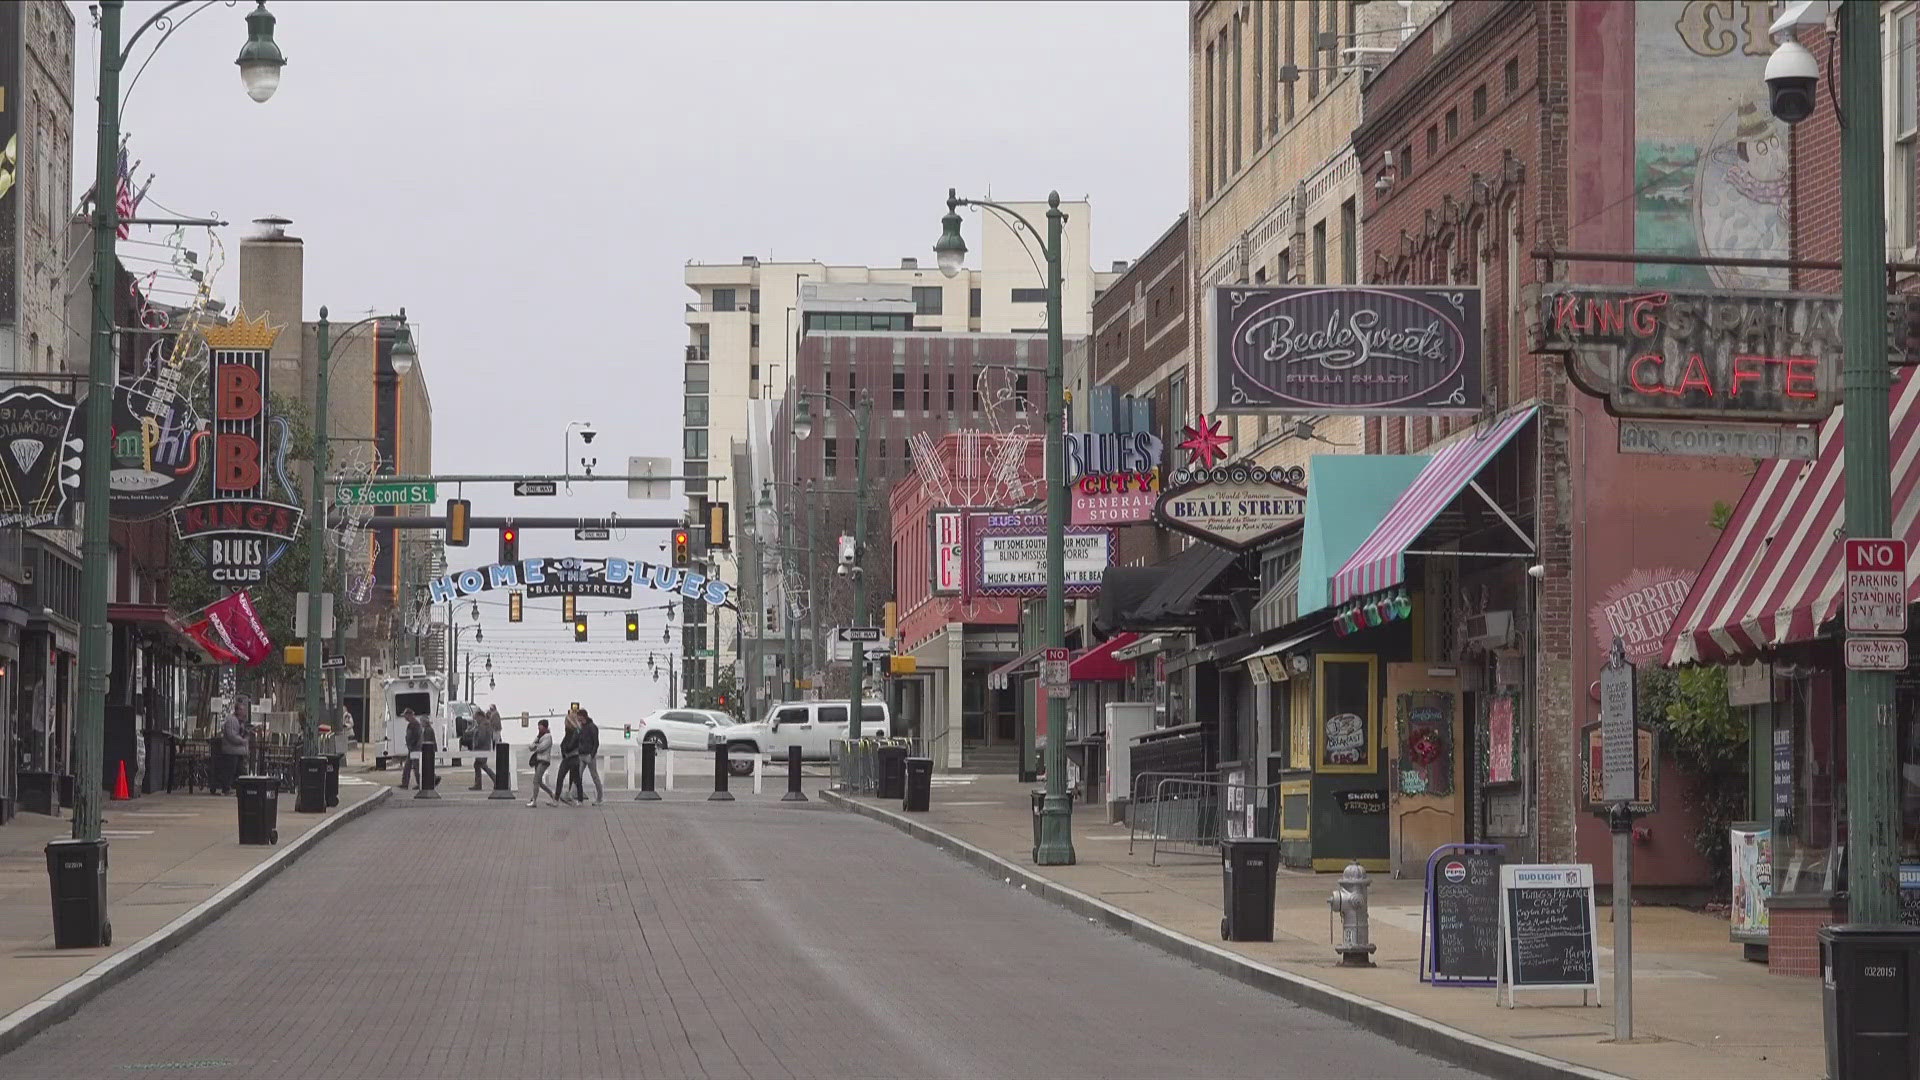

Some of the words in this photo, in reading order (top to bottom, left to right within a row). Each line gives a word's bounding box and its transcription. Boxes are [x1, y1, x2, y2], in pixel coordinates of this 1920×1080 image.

[1286, 373, 1344, 384] SUGAR
[1351, 373, 1410, 384] SHACK
[1631, 353, 1818, 399] CAFE
[1063, 431, 1153, 488] BLUES
[1176, 467, 1302, 483] WELCOME
[526, 485, 539, 493] ONE
[540, 485, 553, 493] WAY
[1080, 473, 1156, 496] CITY
[358, 487, 407, 504] Second
[410, 486, 432, 502] St.
[1077, 495, 1152, 509] GENERAL
[1174, 501, 1232, 517] BEALE
[1238, 500, 1305, 516] STREET
[186, 504, 289, 533] KING'S
[1090, 508, 1140, 520] STORE
[988, 515, 1021, 527] BLUES
[1024, 515, 1047, 526] CITY
[993, 540, 1005, 549] PUT
[1007, 540, 1024, 549] SOME
[1025, 539, 1046, 549] SOUTH
[1075, 537, 1099, 548] MOUTH
[212, 539, 262, 565] BLUES
[1000, 551, 1020, 561] BLIND
[1857, 544, 1894, 567] NO
[561, 557, 583, 569] OF
[212, 568, 262, 581] CLUB
[558, 569, 590, 582] THE
[988, 573, 1009, 584] MUSIC
[1010, 573, 1016, 582] &
[1017, 573, 1036, 583] MEAT
[1037, 572, 1047, 582] TH
[1079, 571, 1088, 581] BE
[1851, 574, 1898, 587] PARKING
[429, 557, 545, 606] HOME
[605, 557, 731, 606] BLUES
[535, 585, 573, 594] BEALE
[578, 583, 624, 594] STREET
[1851, 591, 1902, 605] STANDING
[1604, 578, 1690, 638] BURRITO
[1851, 605, 1875, 617] ANY
[1050, 650, 1065, 659] NO
[1862, 655, 1890, 664] ZONE
[1518, 873, 1538, 881] BUD
[1538, 873, 1563, 881] LIGHT
[1900, 871, 1920, 882] BU
[1864, 966, 1897, 977] 03220157
